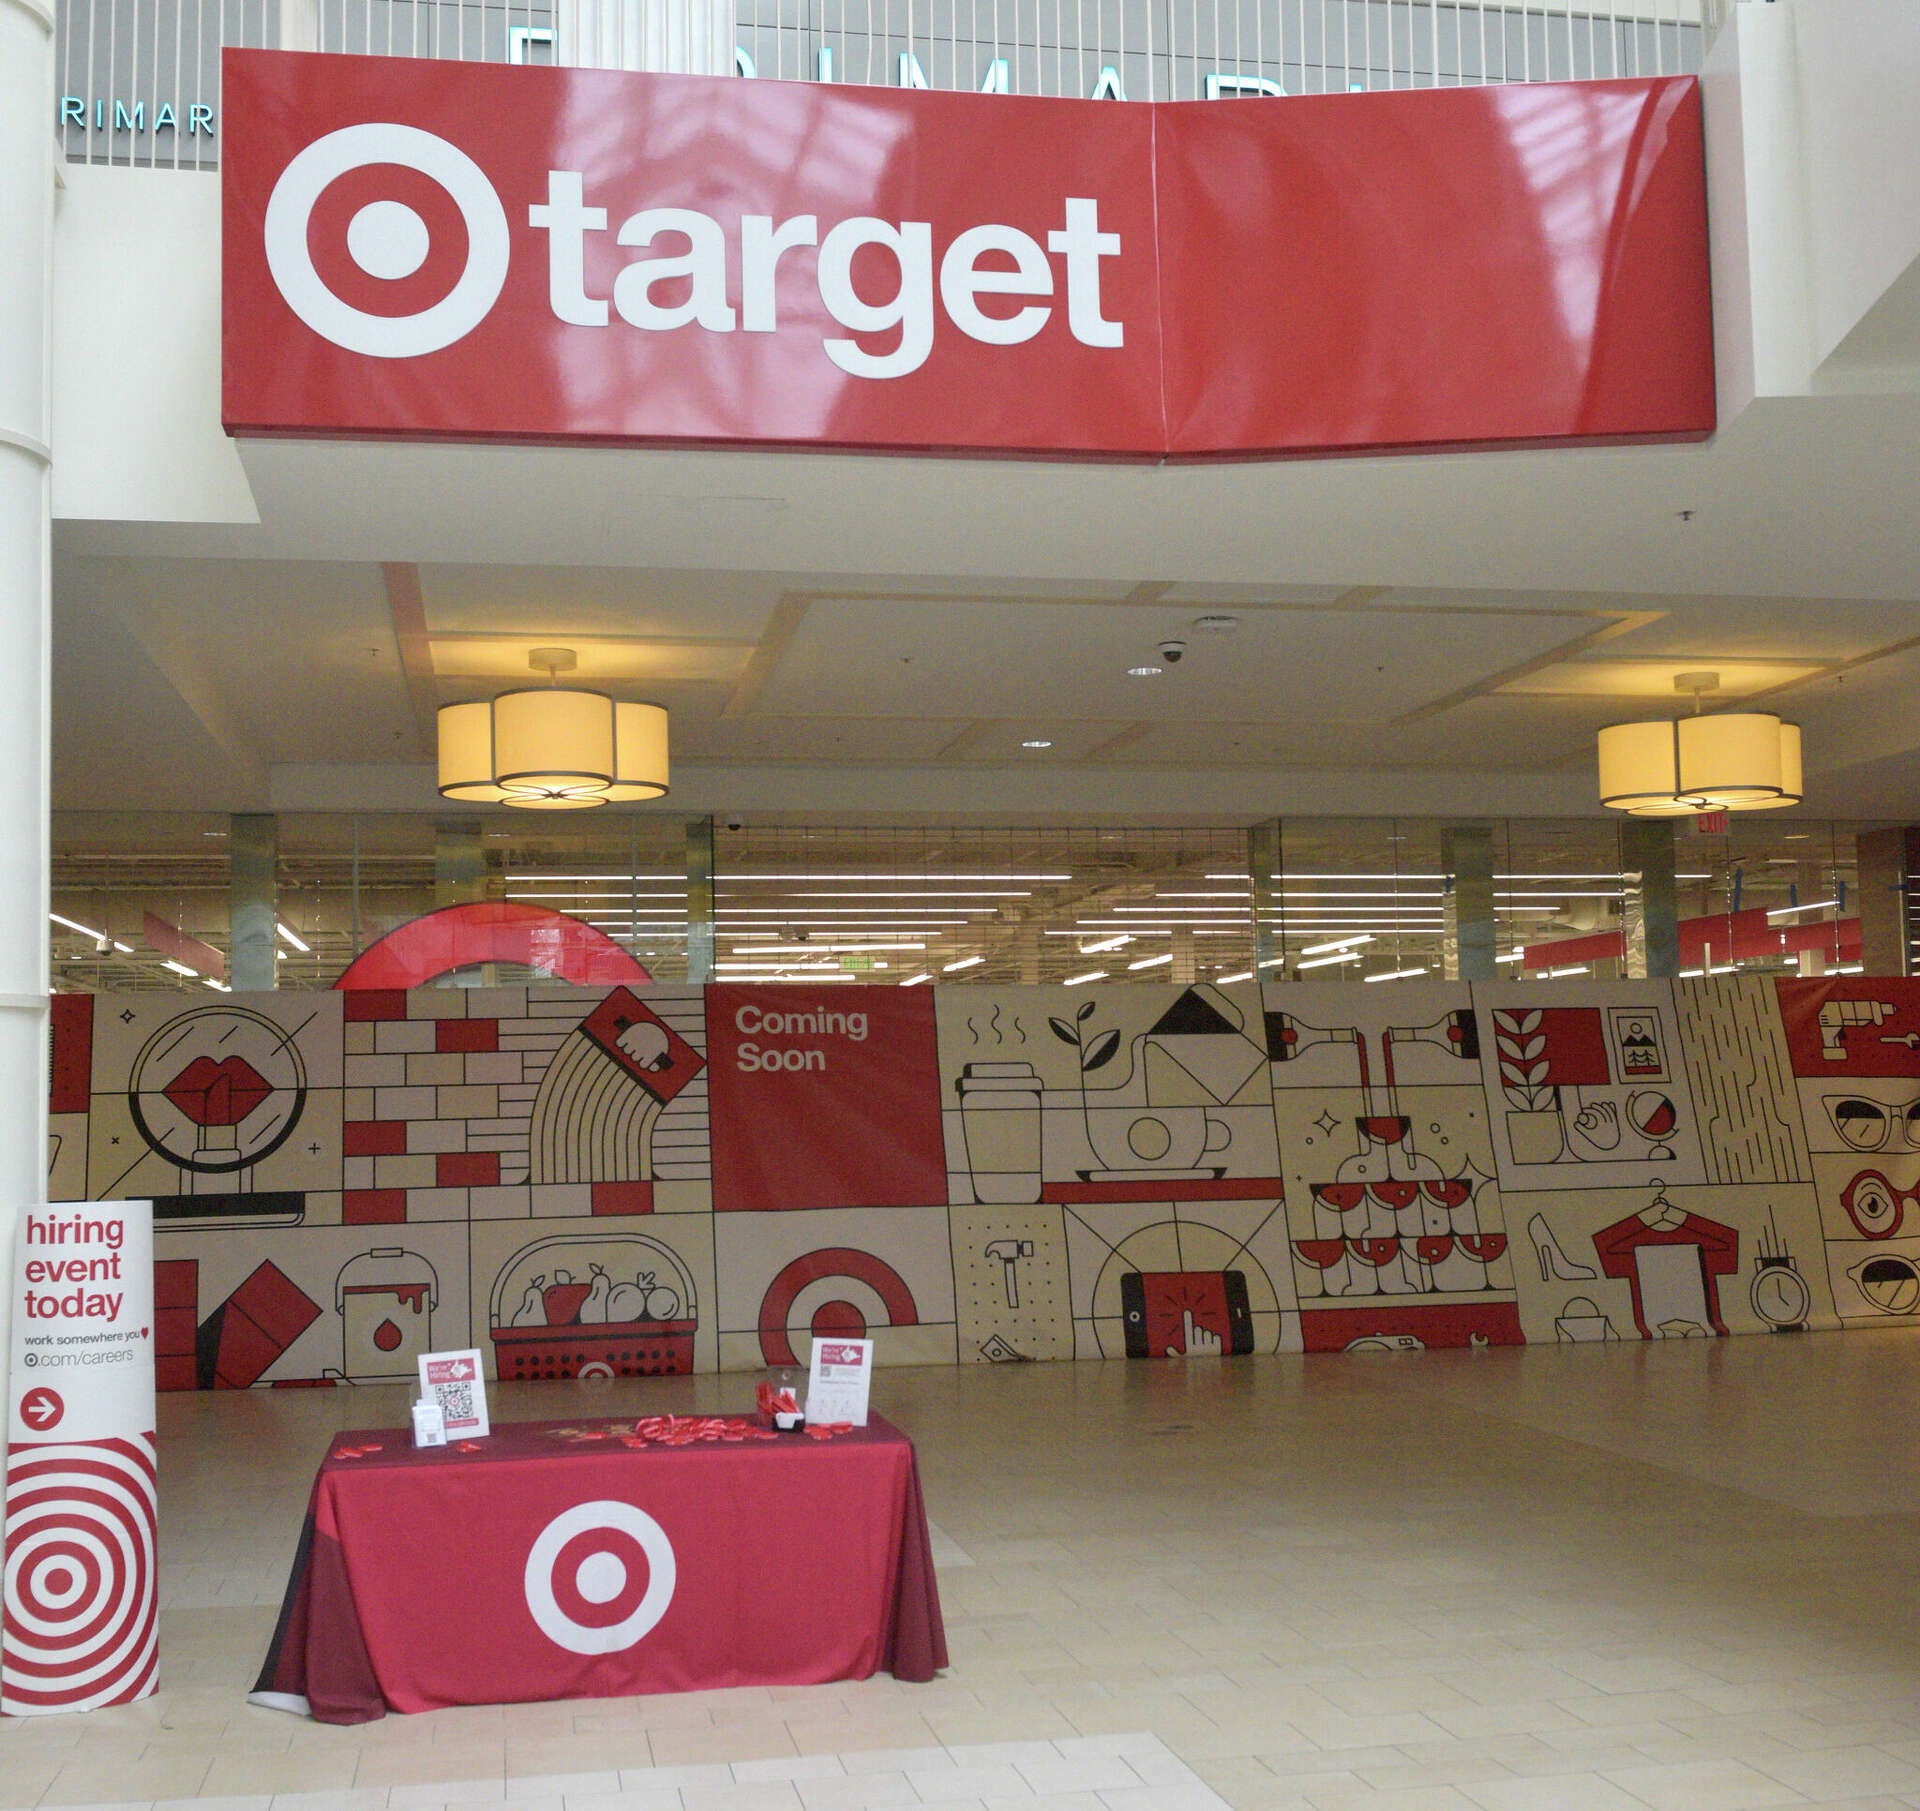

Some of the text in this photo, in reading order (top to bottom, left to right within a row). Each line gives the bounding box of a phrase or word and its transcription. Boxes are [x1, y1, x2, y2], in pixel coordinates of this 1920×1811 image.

[61, 96, 214, 135] RIMAR
[528, 170, 1124, 379] target
[735, 1004, 868, 1041] Coming
[737, 1042, 826, 1072] Soon
[27, 1214, 124, 1250] hiring
[25, 1252, 121, 1283] event
[24, 1287, 124, 1323] today
[24, 1330, 140, 1345] work somewhere you
[38, 1349, 134, 1367] .com/careers
